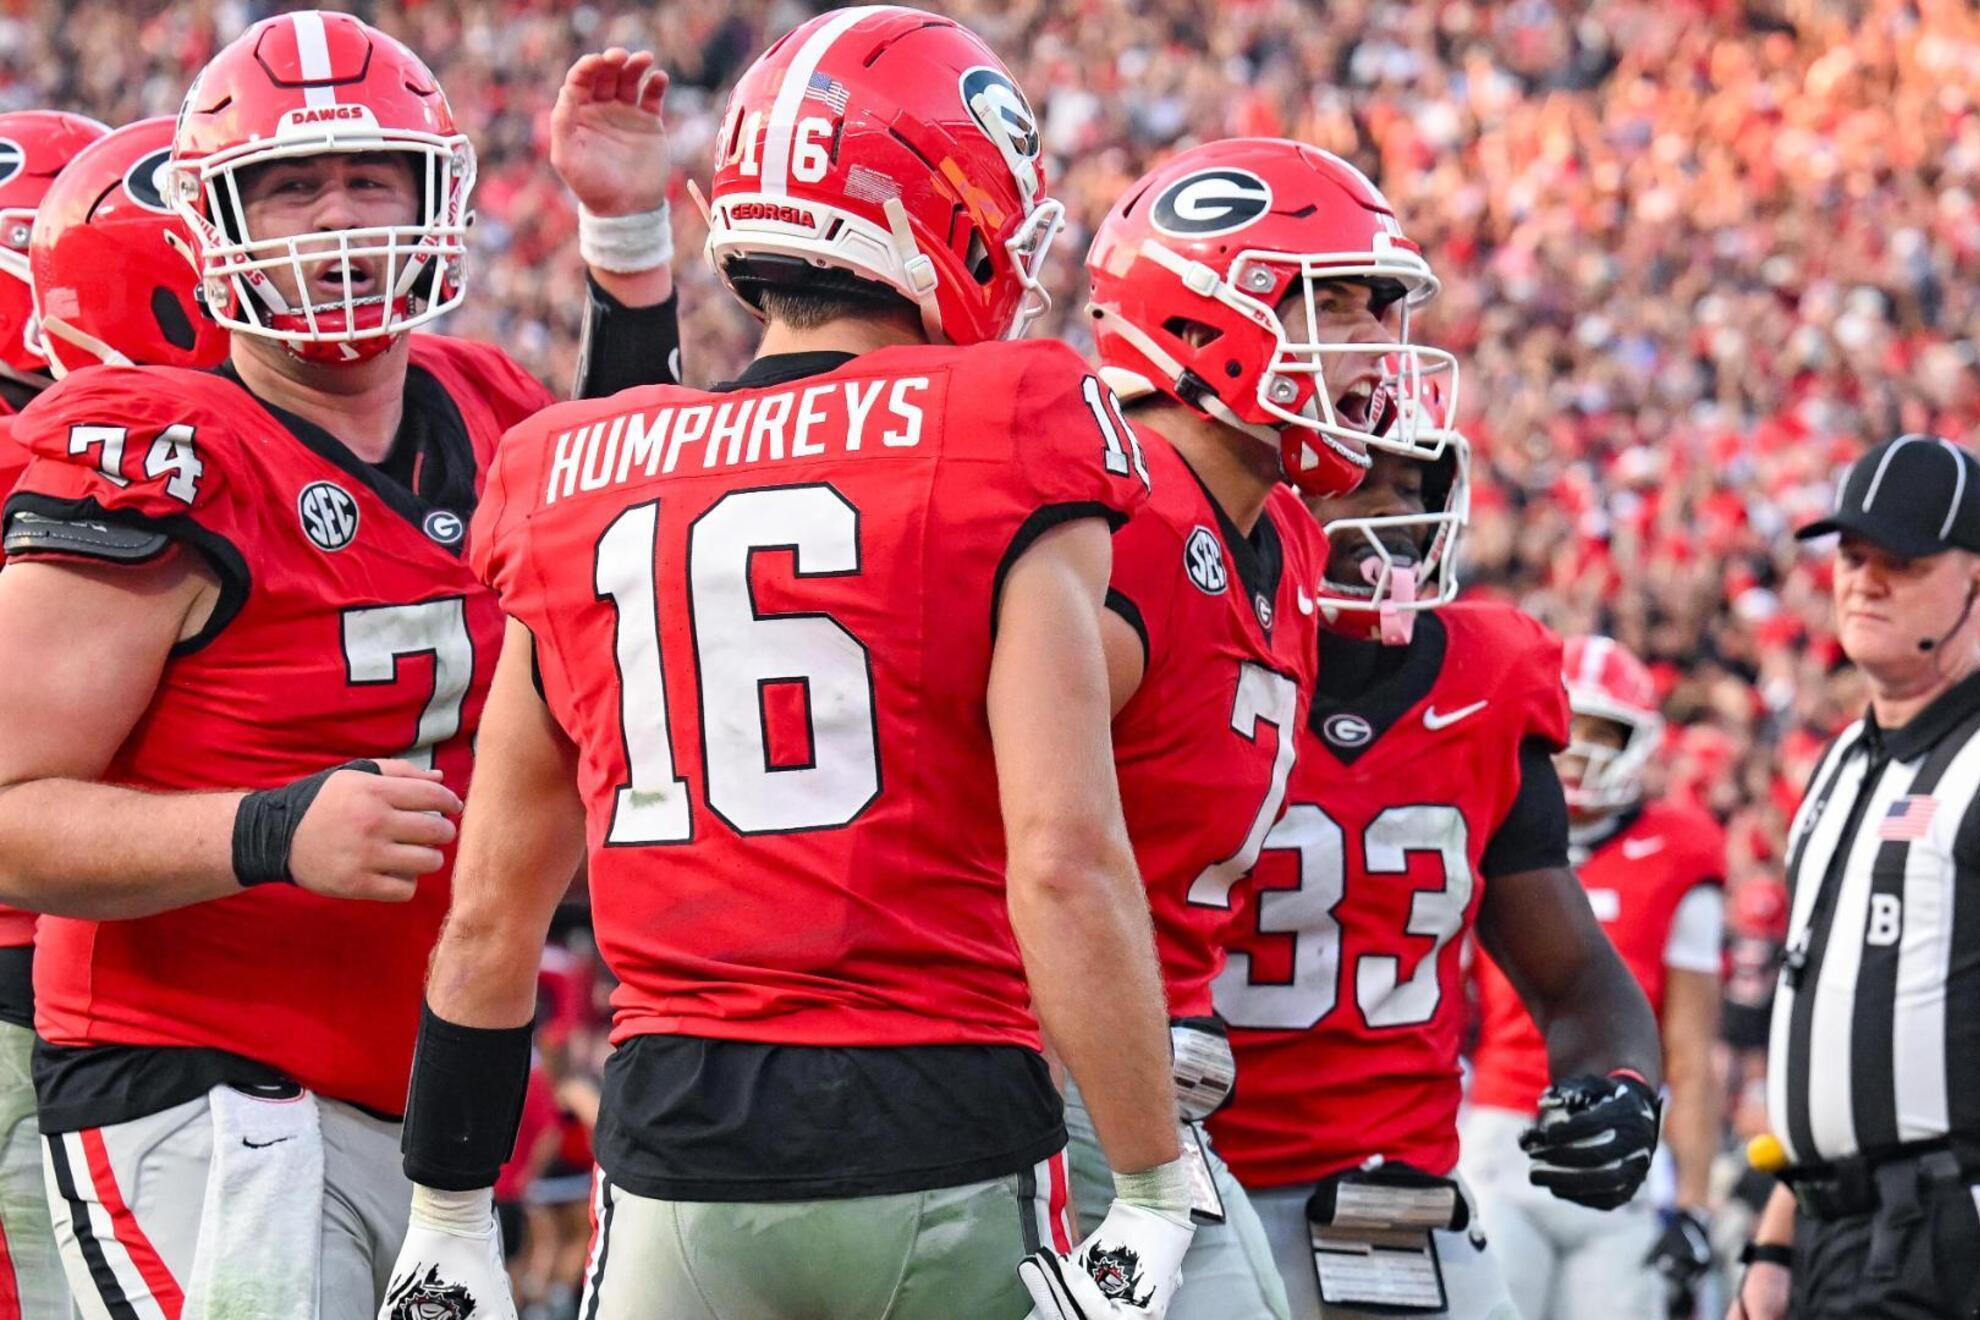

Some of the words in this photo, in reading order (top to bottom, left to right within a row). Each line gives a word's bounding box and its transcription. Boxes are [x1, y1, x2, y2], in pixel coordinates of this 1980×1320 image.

[291, 106, 363, 124] DAWGS
[739, 111, 833, 183] 16
[731, 203, 816, 229] GEORGIA
[68, 422, 204, 506] 74
[546, 376, 929, 506] HUMPHREYS
[303, 487, 353, 547] SEC
[1190, 531, 1225, 589] SEC
[339, 594, 477, 771] 7
[595, 481, 883, 847] 16
[1186, 660, 1298, 910] 7
[1211, 804, 1473, 1030] 33
[1867, 893, 1901, 946] B
